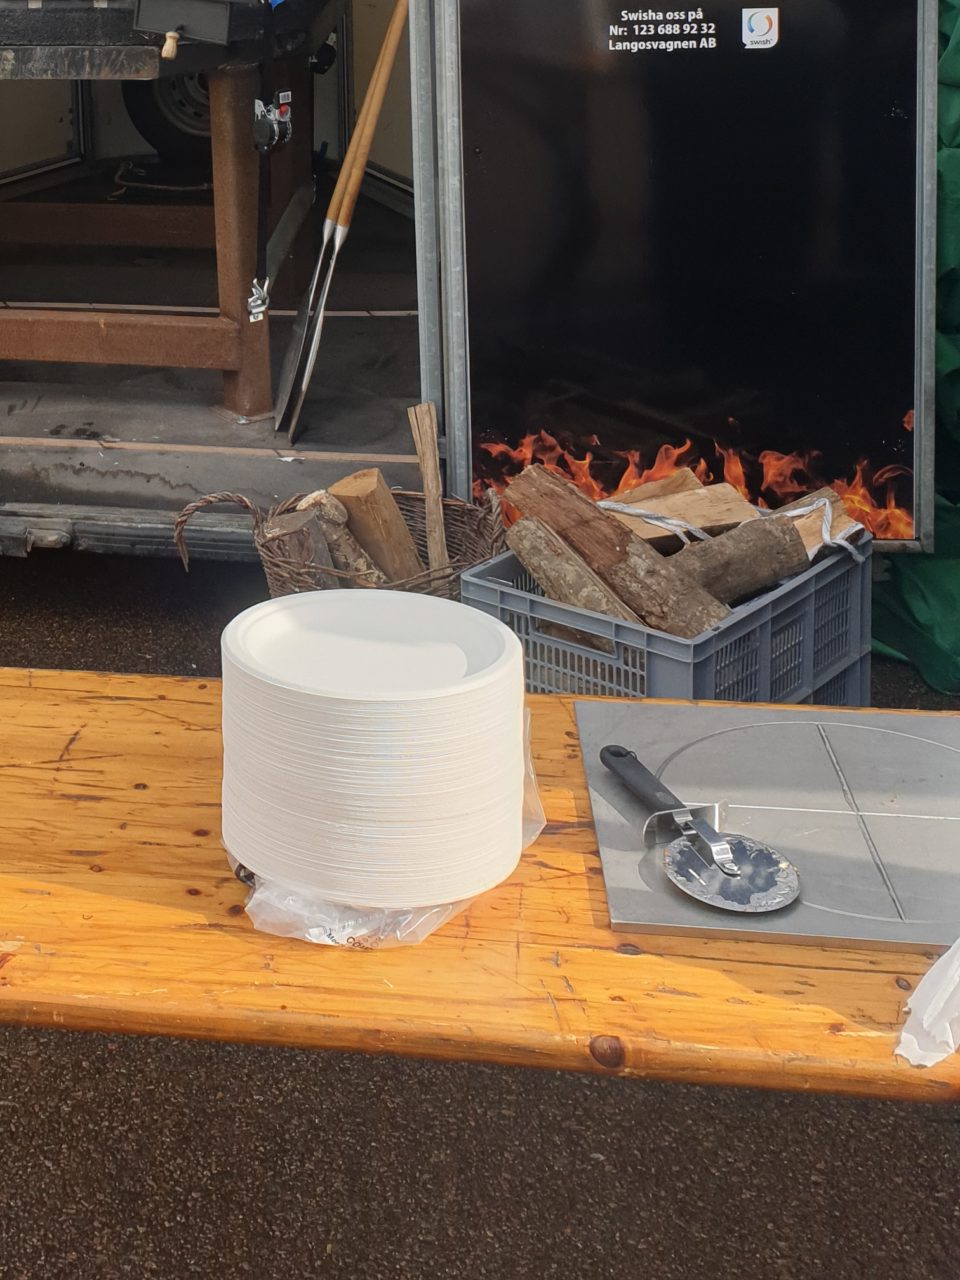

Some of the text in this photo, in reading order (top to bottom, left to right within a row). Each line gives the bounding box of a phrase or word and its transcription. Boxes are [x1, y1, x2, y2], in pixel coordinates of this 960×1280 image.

[621, 8, 703, 22] Swisha oss på
[609, 23, 715, 35] Nr: 123 688 92 32
[609, 38, 716, 52] Langosvagnen AB
